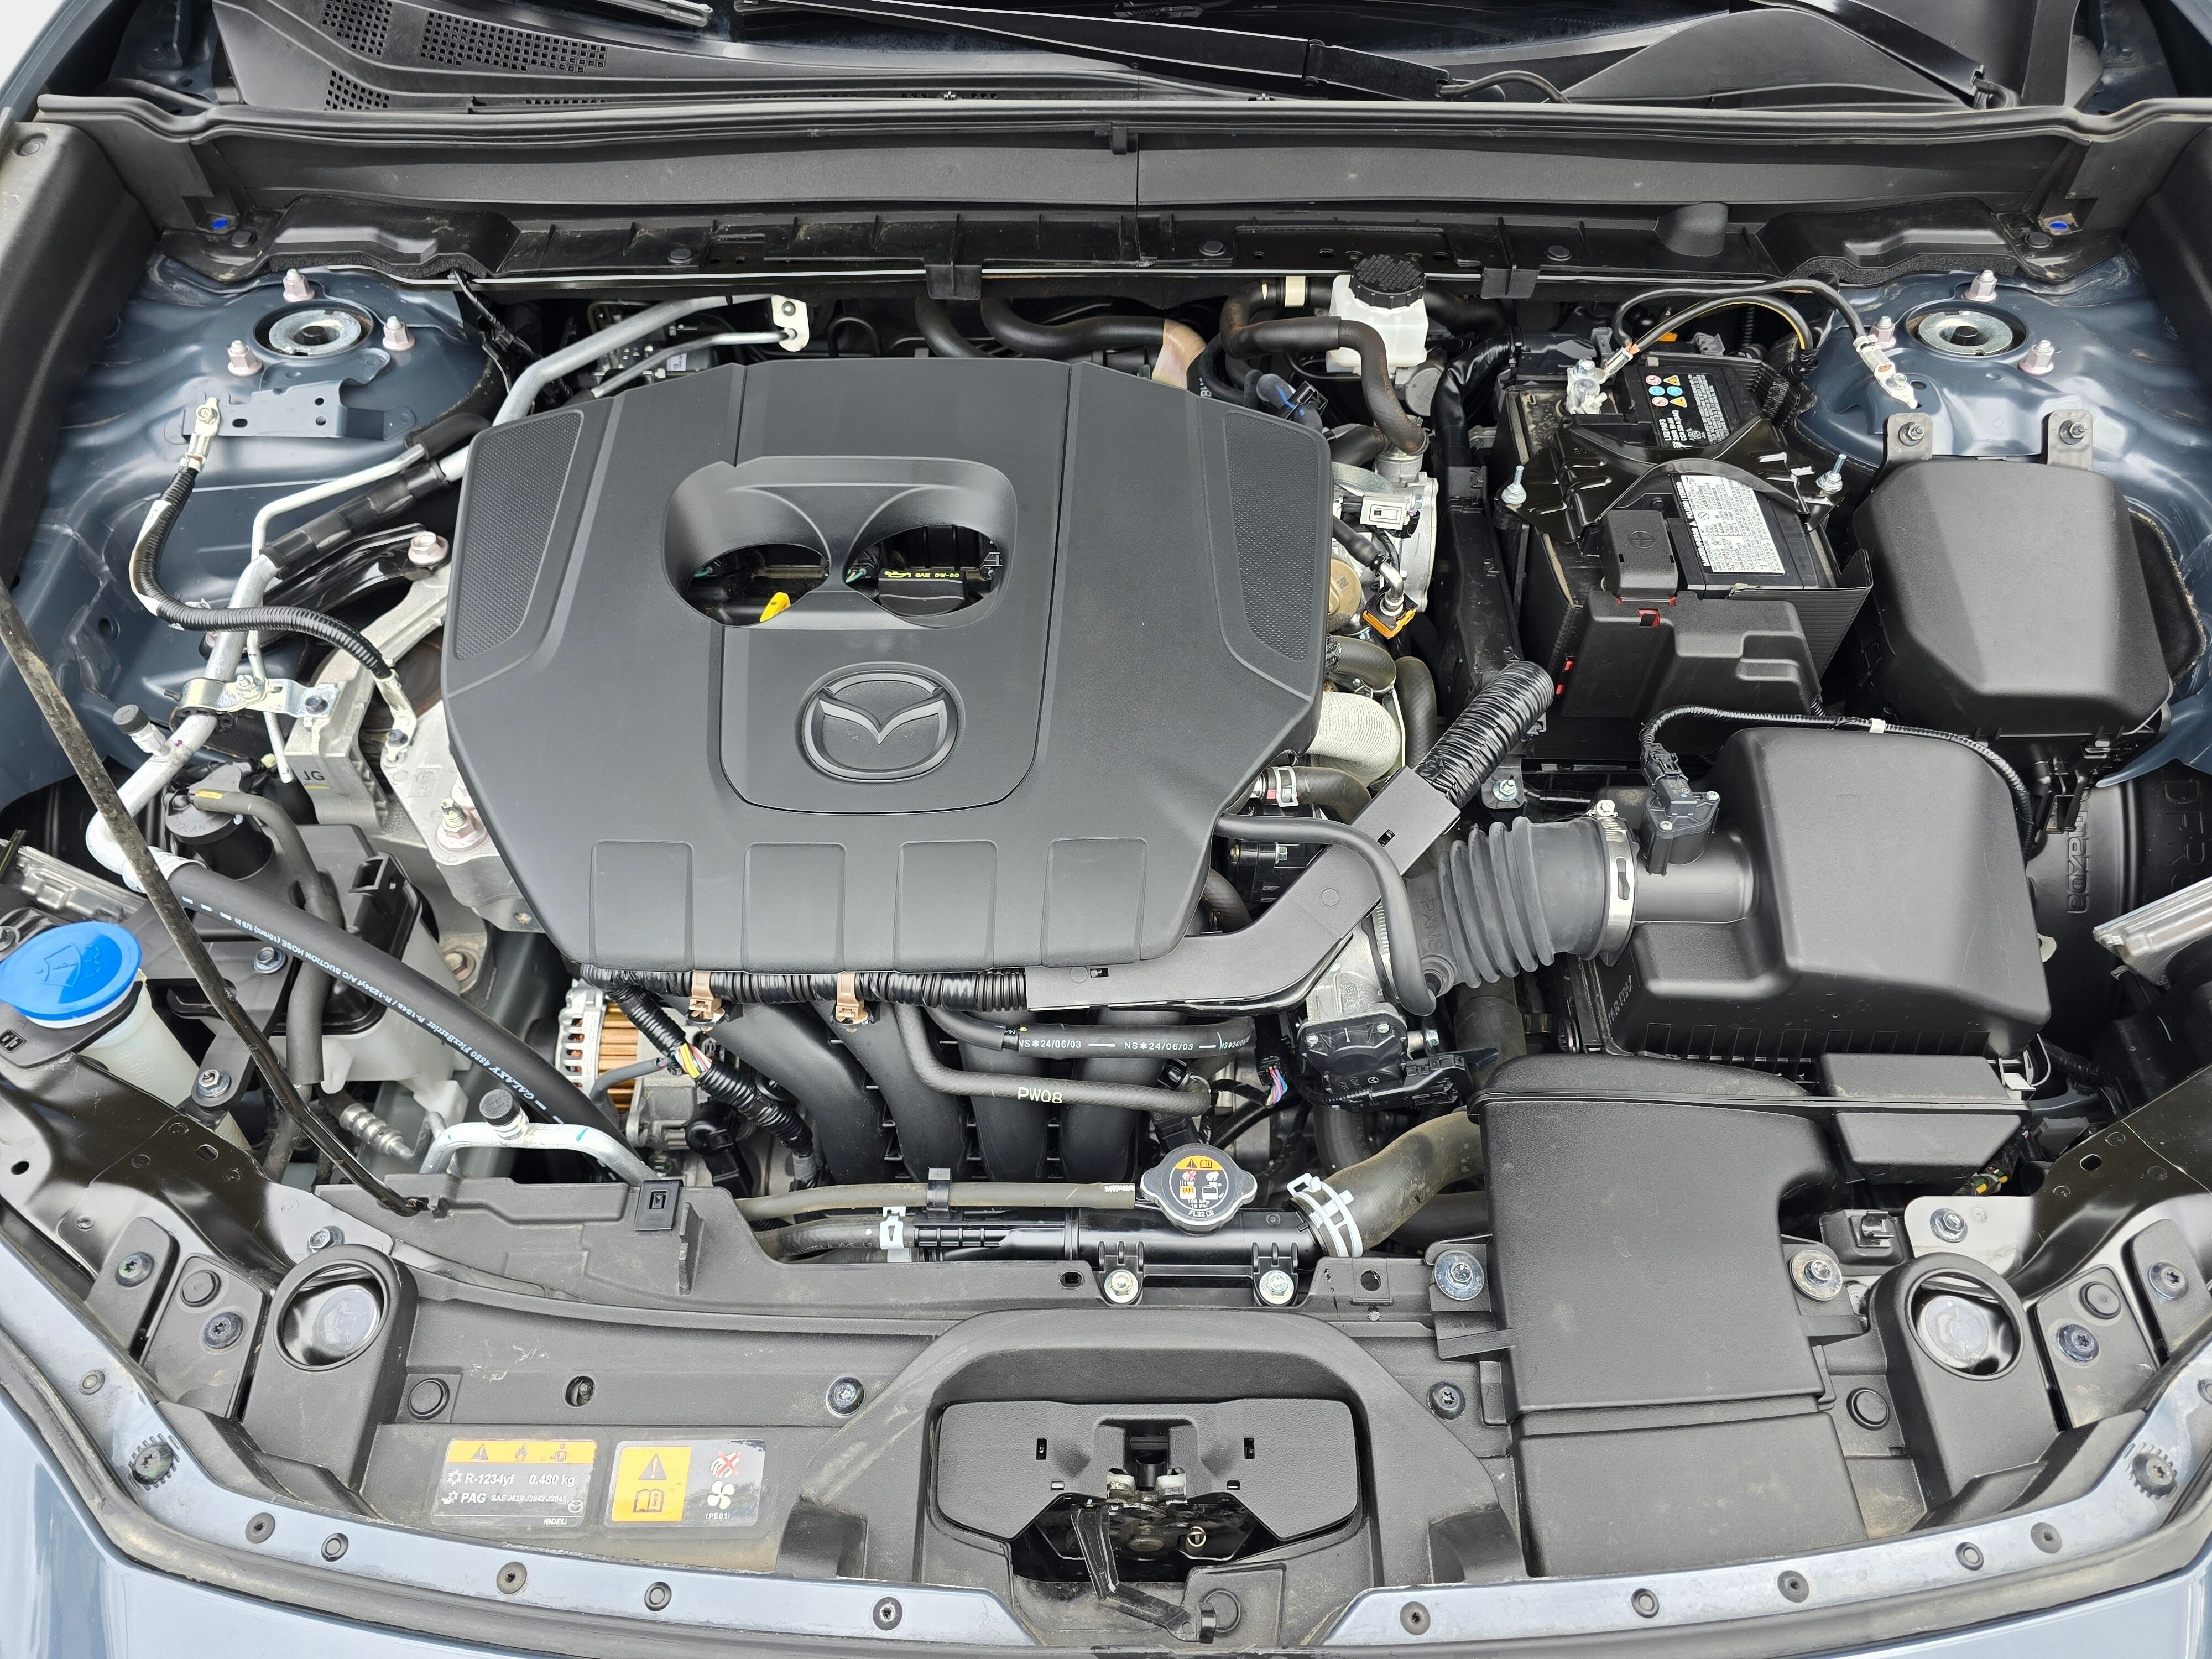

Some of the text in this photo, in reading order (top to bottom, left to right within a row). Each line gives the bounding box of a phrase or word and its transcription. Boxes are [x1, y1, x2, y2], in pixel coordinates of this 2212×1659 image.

[170, 816, 213, 832] COOLANT
[2067, 811, 2089, 913] mazda
[254, 925, 280, 944] (16mm)
[281, 939, 304, 956] HOSE
[305, 952, 341, 975] SUCTION
[342, 972, 358, 984] A/C
[357, 980, 392, 1004] R-1234yf
[397, 1002, 425, 1023] R-134a
[426, 1020, 472, 1053] FlexBarrier
[470, 1051, 491, 1067] 4880
[488, 1066, 535, 1100] GALAXY
[1018, 1087, 1063, 1104] PW08
[465, 1473, 576, 1487] R-1234yf 0.480 kg
[461, 1493, 487, 1503] PAG
